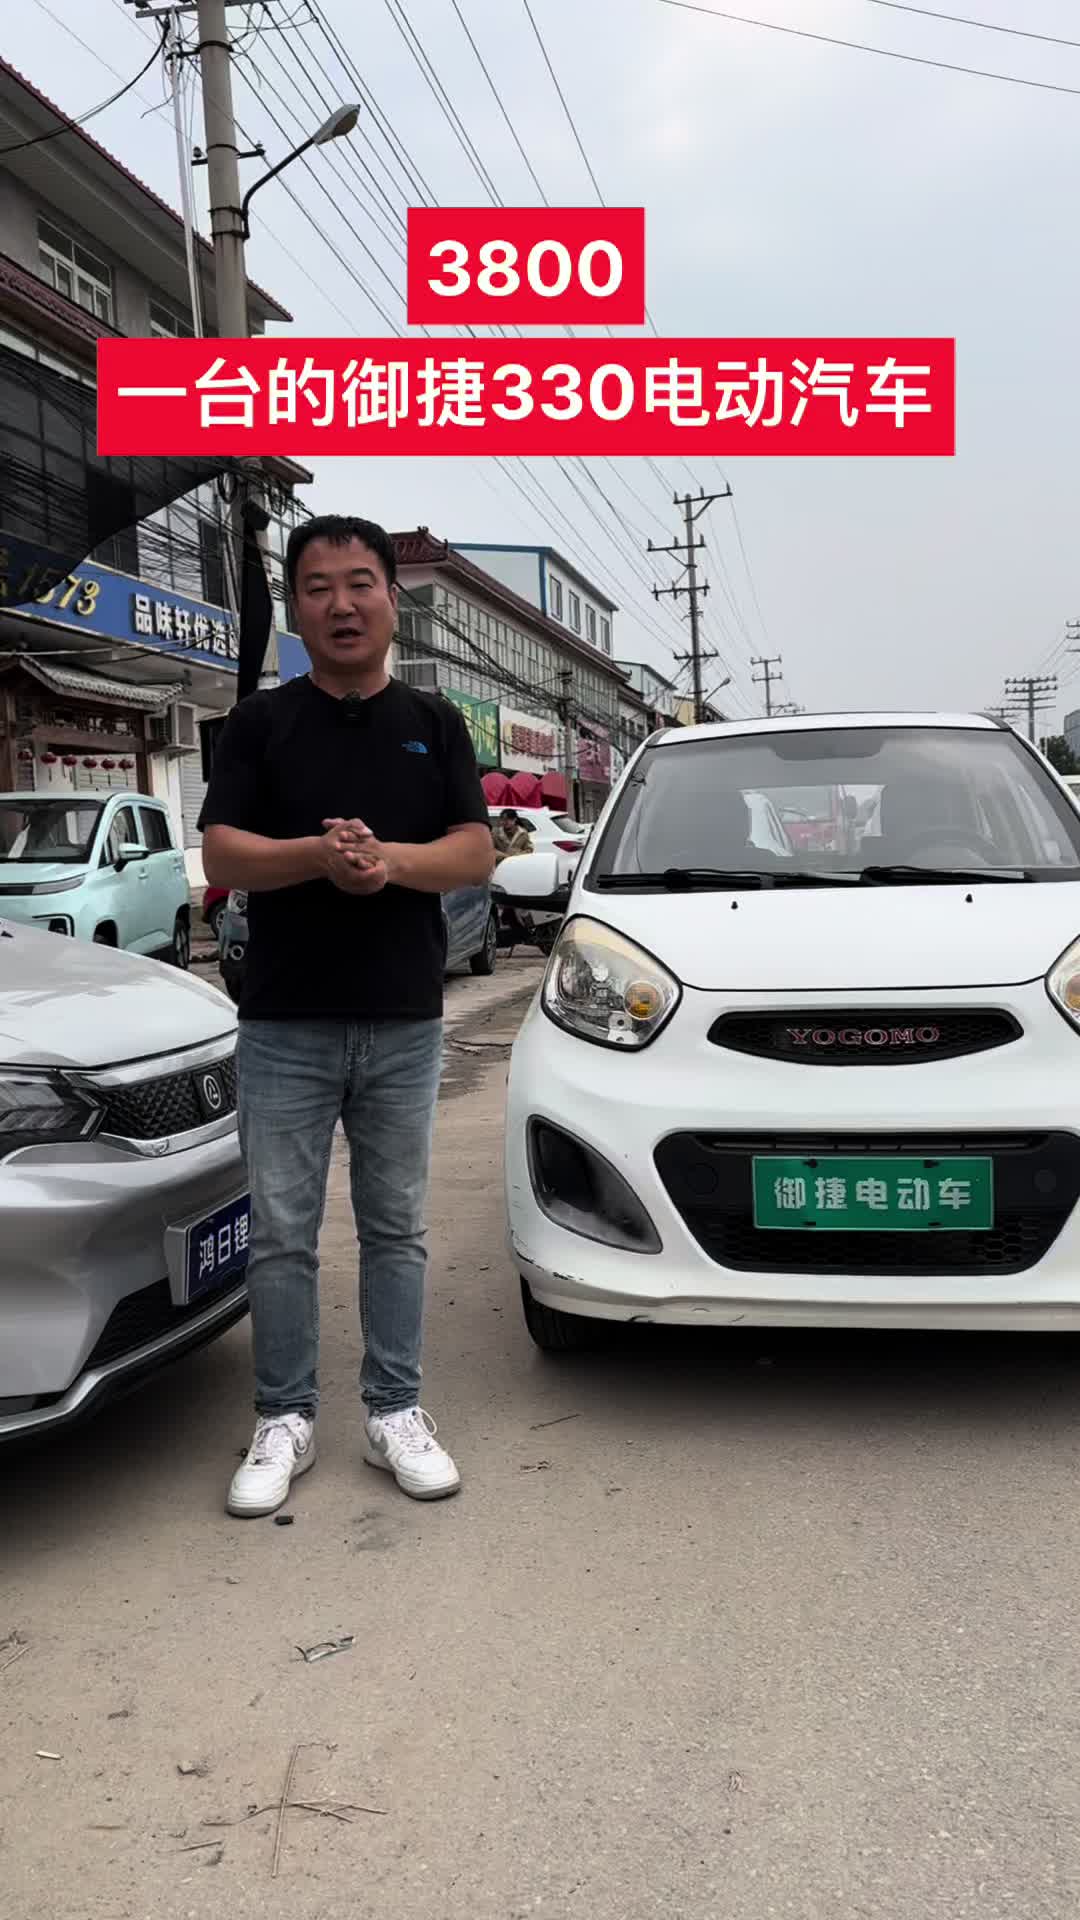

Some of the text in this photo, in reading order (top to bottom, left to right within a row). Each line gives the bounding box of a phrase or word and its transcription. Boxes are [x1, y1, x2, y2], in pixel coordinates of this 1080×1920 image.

[786, 1026, 941, 1045] YOGOMO
[773, 1176, 972, 1211] 御捷电动车
